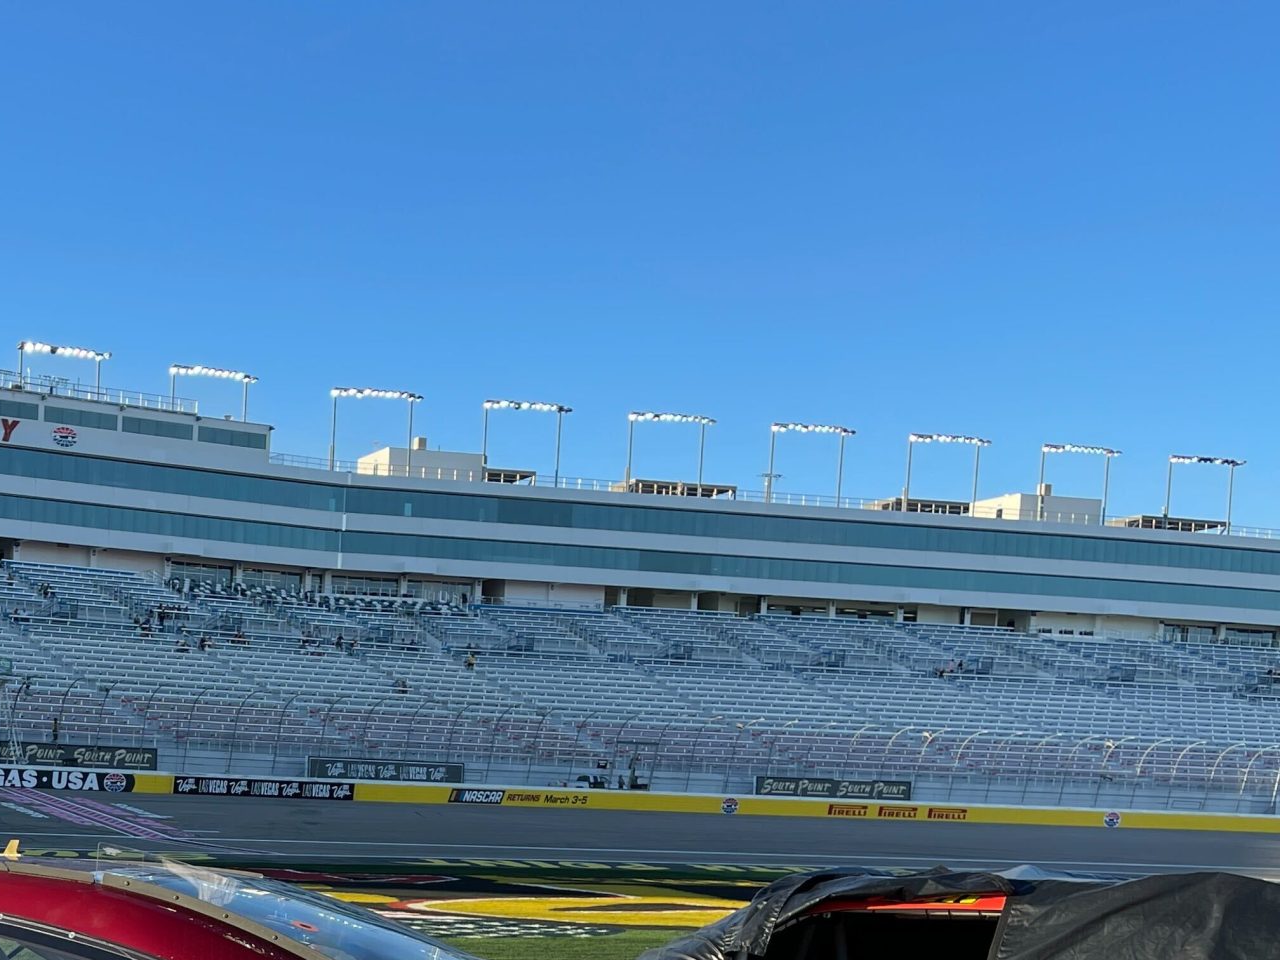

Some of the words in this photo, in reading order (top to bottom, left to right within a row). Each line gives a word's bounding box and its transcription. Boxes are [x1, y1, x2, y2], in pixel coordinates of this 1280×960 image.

[73, 748, 111, 763] SOUTH
[114, 749, 153, 767] POINT
[51, 770, 100, 791] USA
[798, 780, 832, 795] POINT
[463, 790, 503, 803] NASCAR
[506, 793, 541, 802] RETURNS
[544, 794, 570, 804] March
[571, 795, 588, 805] 3-5
[873, 782, 906, 798] POINT
[827, 804, 868, 816] PIRELLI
[878, 805, 918, 819] PIRELLI
[928, 807, 968, 820] PIRELLI
